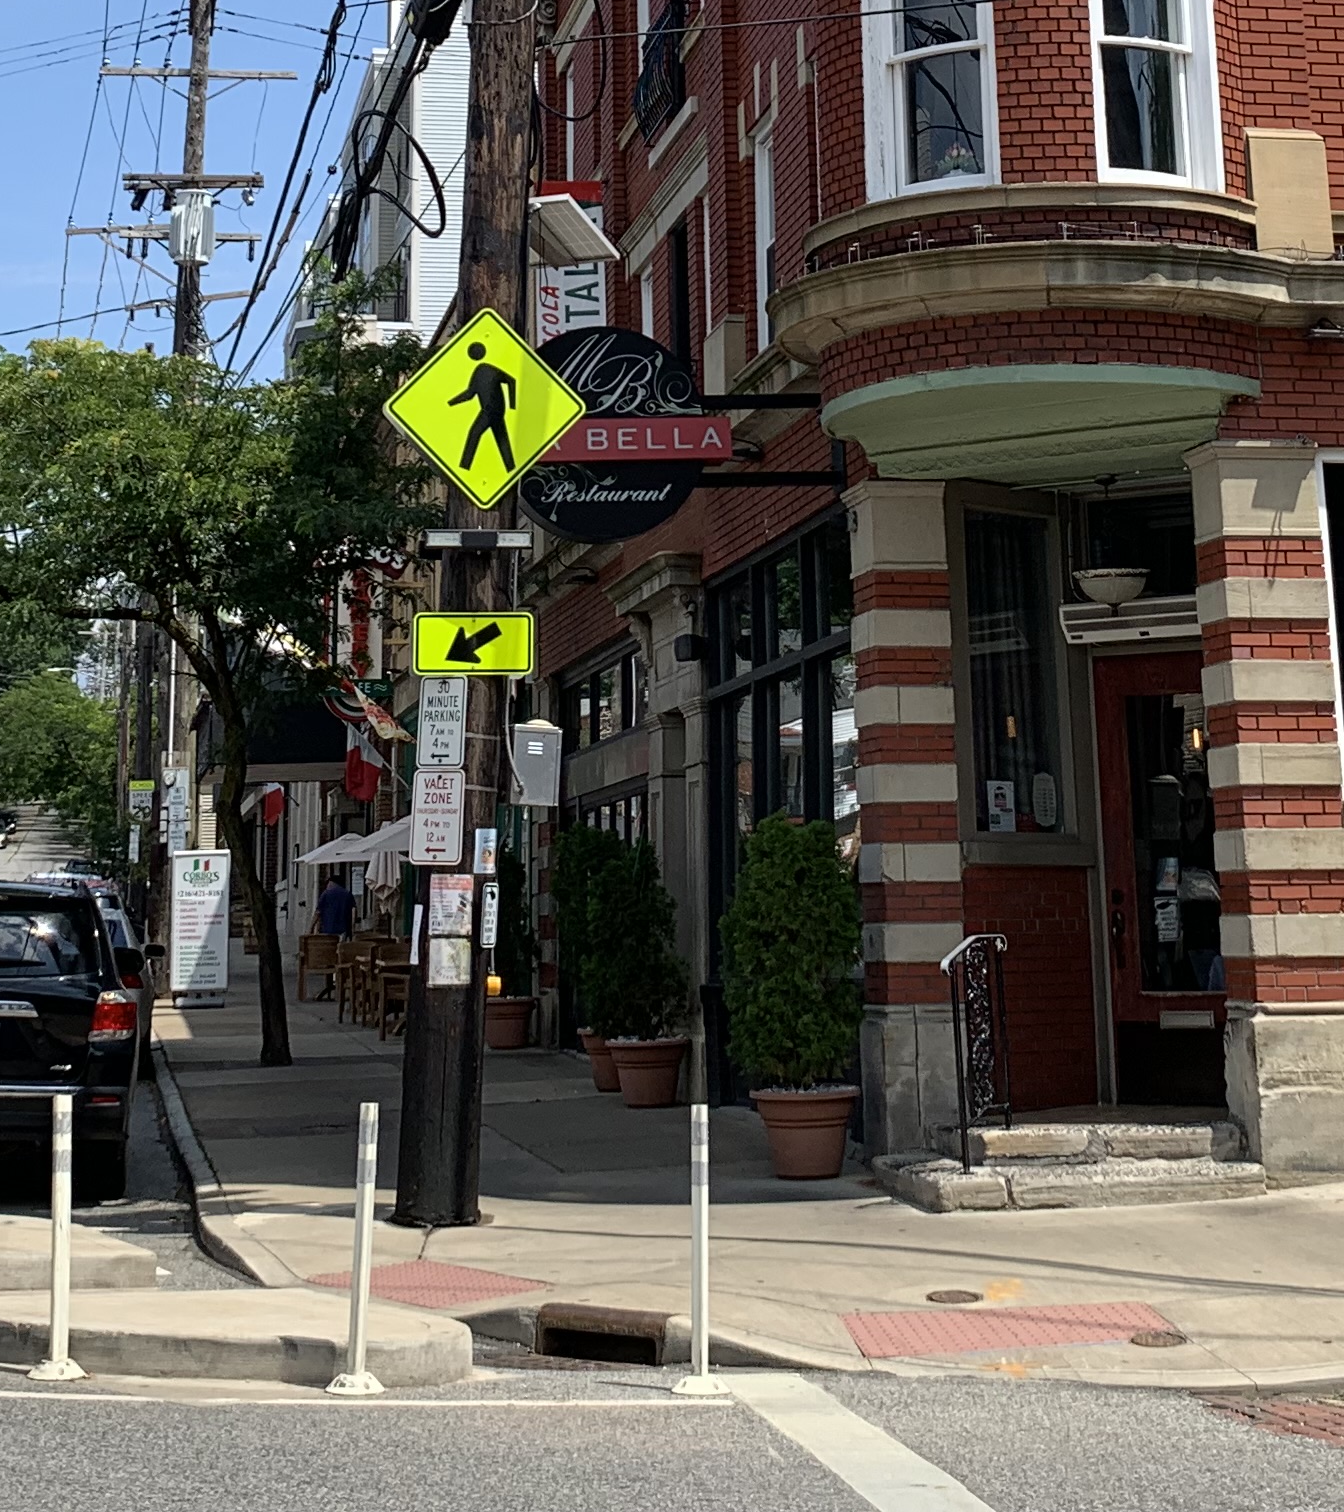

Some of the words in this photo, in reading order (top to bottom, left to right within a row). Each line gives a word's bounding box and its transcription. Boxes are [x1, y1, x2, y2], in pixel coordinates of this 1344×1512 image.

[586, 426, 723, 451] BELLA
[541, 480, 673, 504] Restaurant
[437, 680, 450, 694] 30
[426, 695, 459, 708] MINUTE
[423, 709, 461, 723] PARKING
[423, 778, 455, 790] VALET
[423, 792, 453, 804] ZONE
[426, 831, 434, 843] 12
